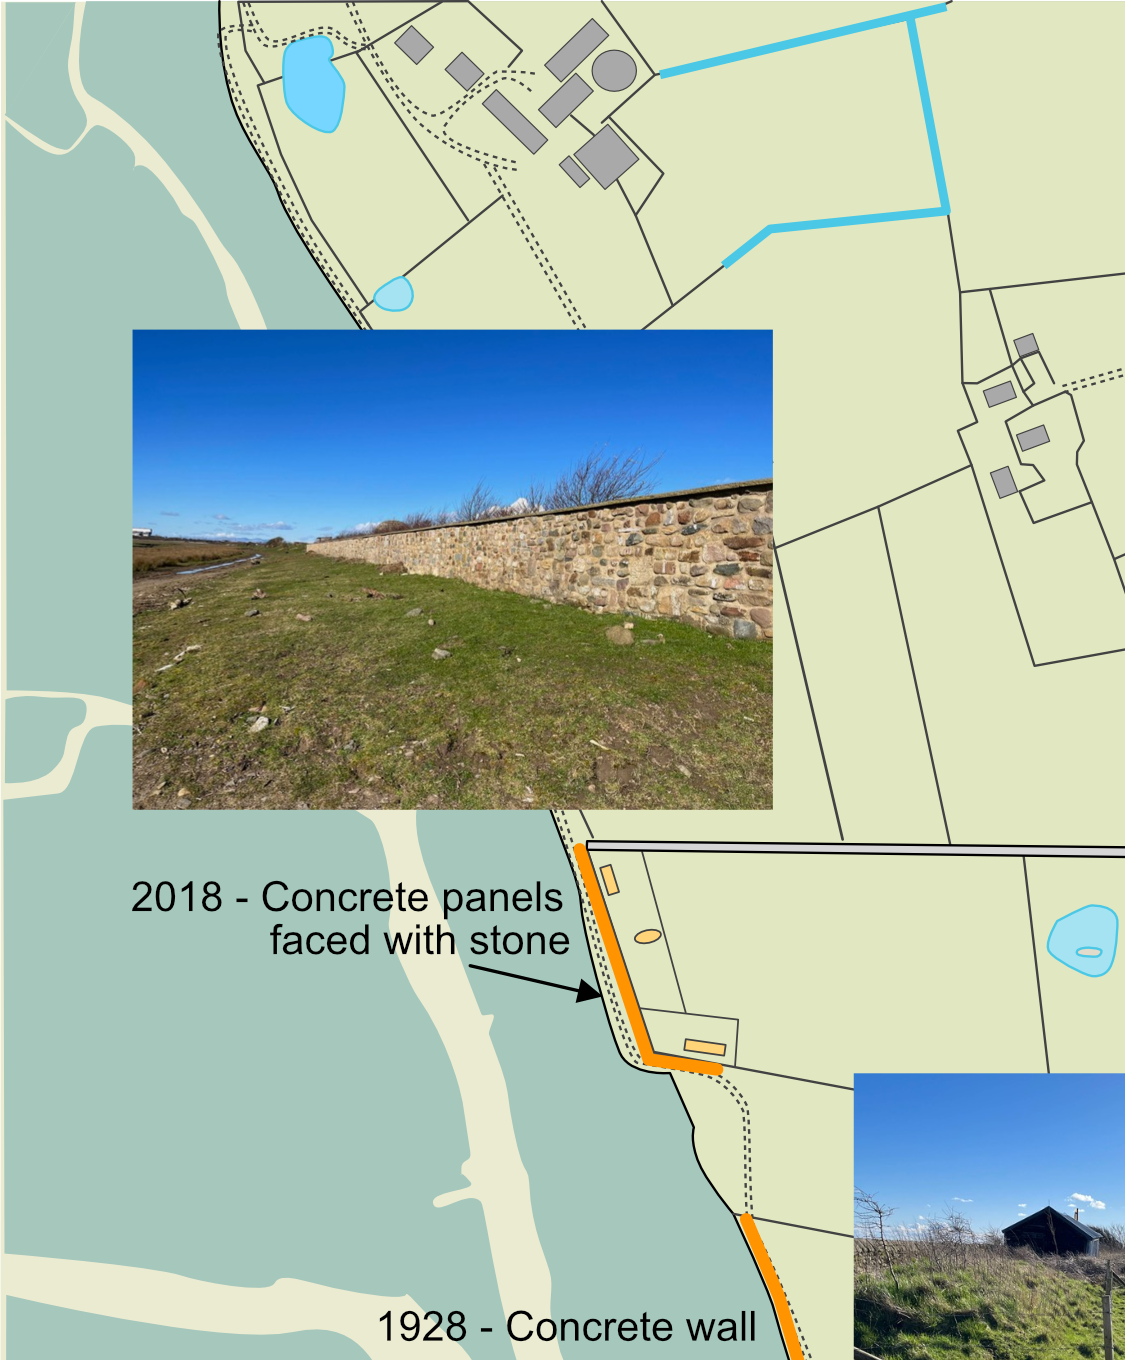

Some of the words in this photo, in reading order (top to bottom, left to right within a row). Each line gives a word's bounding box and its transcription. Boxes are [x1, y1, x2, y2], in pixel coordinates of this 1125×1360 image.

[131, 880, 222, 912] 2018
[262, 880, 429, 912] Concrete
[443, 881, 563, 920] panels
[269, 923, 369, 955] faced
[383, 924, 455, 955] with
[470, 925, 570, 955] stone
[379, 1310, 467, 1342] 1928
[506, 1310, 673, 1342] Concrete
[685, 1310, 755, 1342] wall
